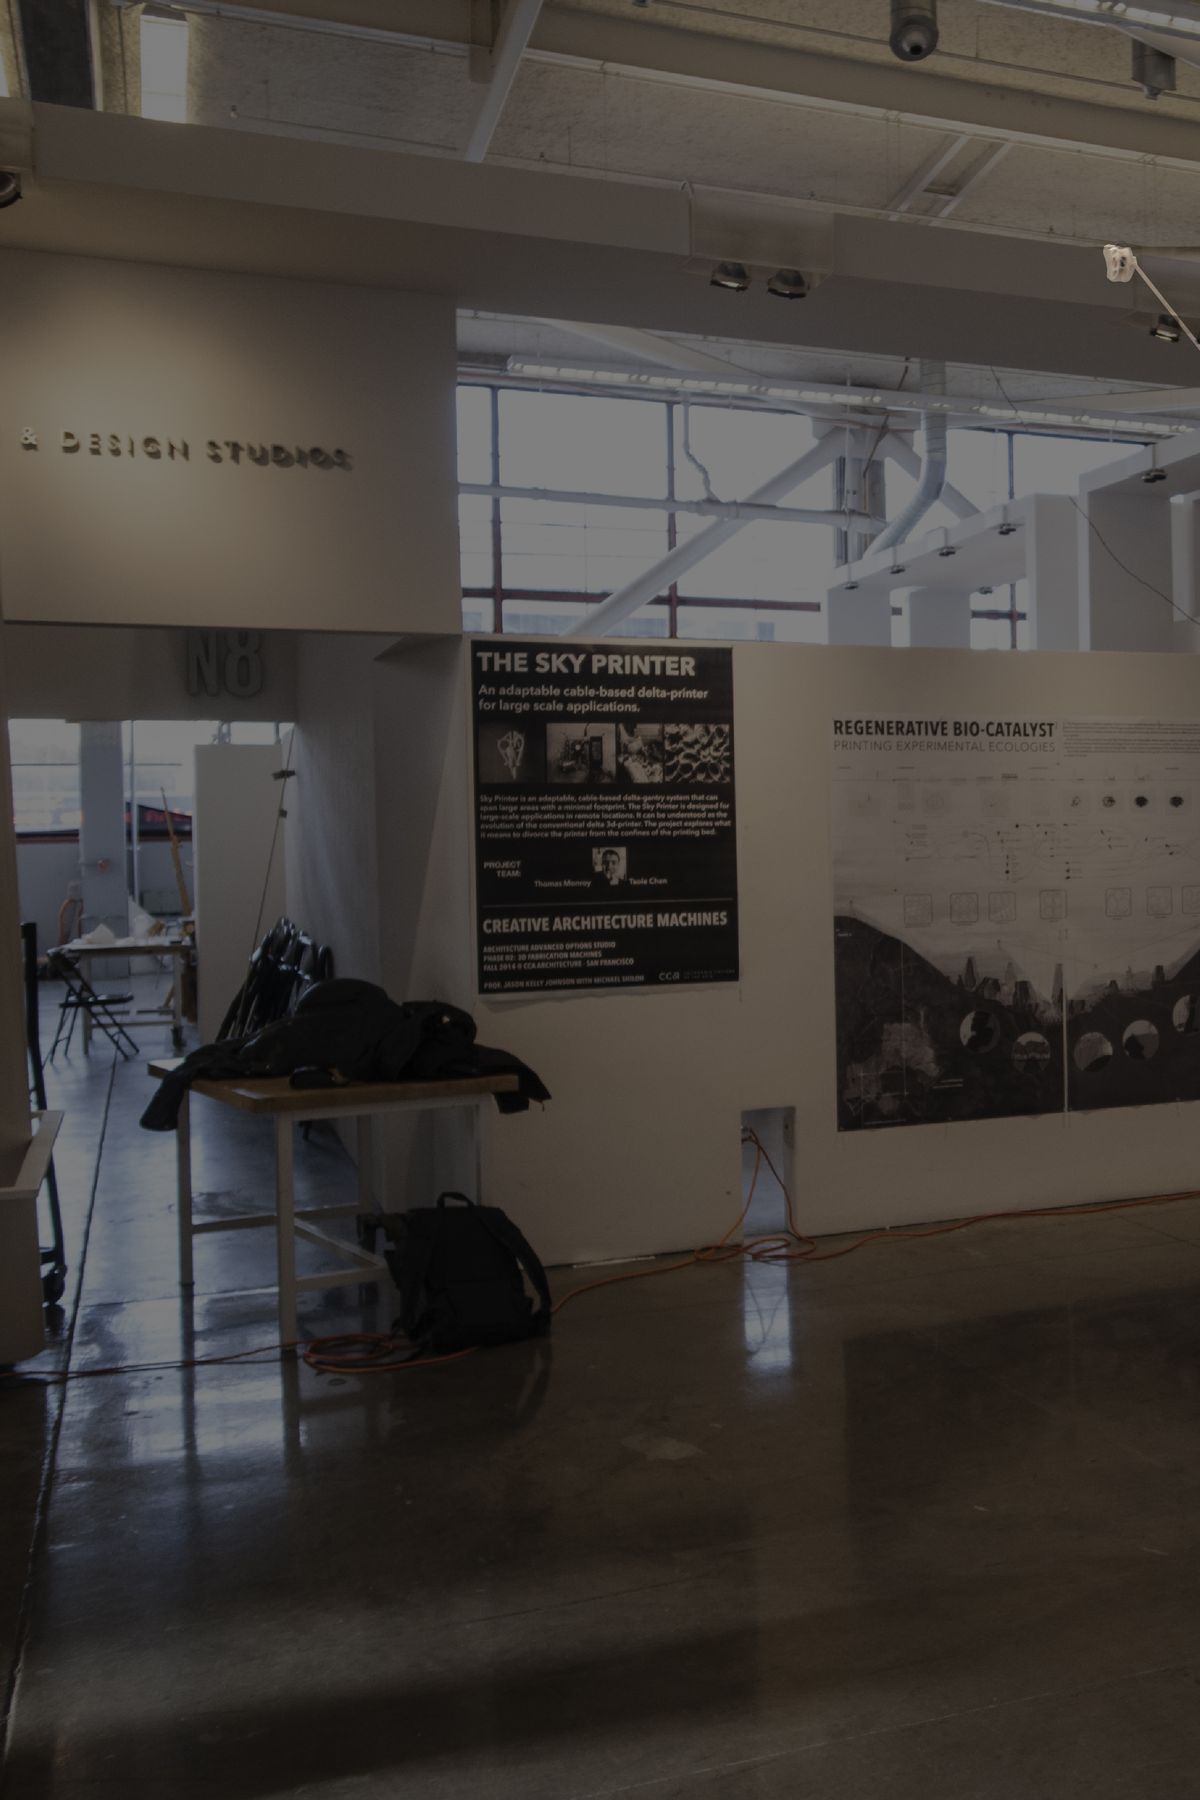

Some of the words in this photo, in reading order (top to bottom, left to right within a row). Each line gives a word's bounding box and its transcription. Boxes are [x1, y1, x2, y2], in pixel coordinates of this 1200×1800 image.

[19, 427, 39, 451] &
[60, 430, 191, 461] DESIGN
[207, 439, 353, 471] STUDIOS
[476, 652, 528, 672] THE
[536, 652, 586, 674] SKY
[591, 655, 697, 677] PRINTER
[478, 685, 495, 695] An
[499, 685, 560, 698] adaptable
[563, 686, 635, 698] cable-based
[638, 687, 709, 701] delta-printer
[479, 700, 496, 710] for
[499, 701, 529, 714] large
[533, 701, 563, 711] scale
[566, 701, 641, 714] applications.
[833, 720, 948, 737] REGENERATIVE
[953, 721, 1054, 738] BIO-CATALYST
[833, 740, 892, 752] PRINTING
[896, 741, 985, 753] EXPERIMENTAL
[988, 742, 1055, 753] ECOLOGIES
[483, 861, 521, 870] PROJECT
[534, 880, 562, 888] Thomas
[563, 880, 592, 889] Monroy
[483, 918, 550, 934] CREATIVE
[552, 915, 654, 932] ARCHITECTURE
[656, 912, 728, 928] MACHINES
[483, 944, 529, 954] ARCHITECTURE
[530, 943, 564, 952] ADVANCED
[565, 942, 593, 950] OPTIONS
[594, 941, 616, 949] STUDIO
[528, 952, 569, 961] FABRICATION
[570, 950, 603, 960] MACHINES
[537, 960, 582, 970] ARCHITECTURE
[600, 958, 635, 966] FRANCISCO
